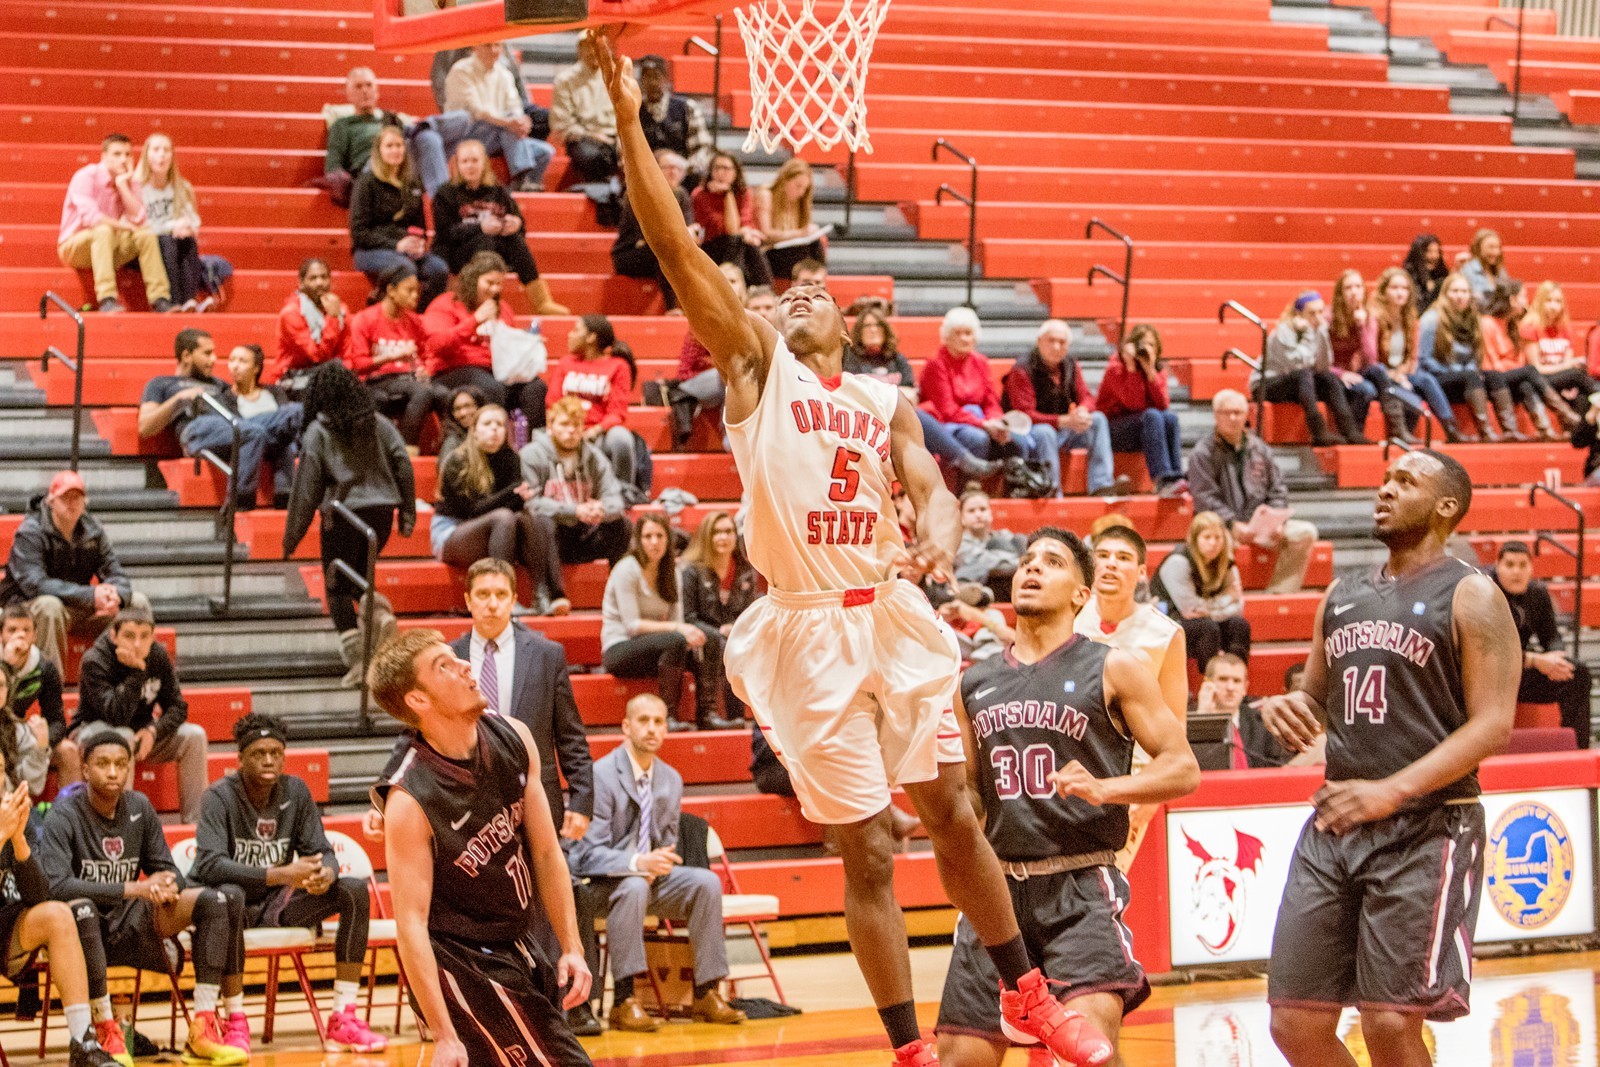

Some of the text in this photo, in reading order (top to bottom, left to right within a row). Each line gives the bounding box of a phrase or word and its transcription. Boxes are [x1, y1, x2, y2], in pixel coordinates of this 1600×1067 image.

[829, 446, 861, 502] 5
[807, 511, 877, 545] STATE
[1343, 664, 1387, 725] 14
[990, 743, 1057, 800] 30
